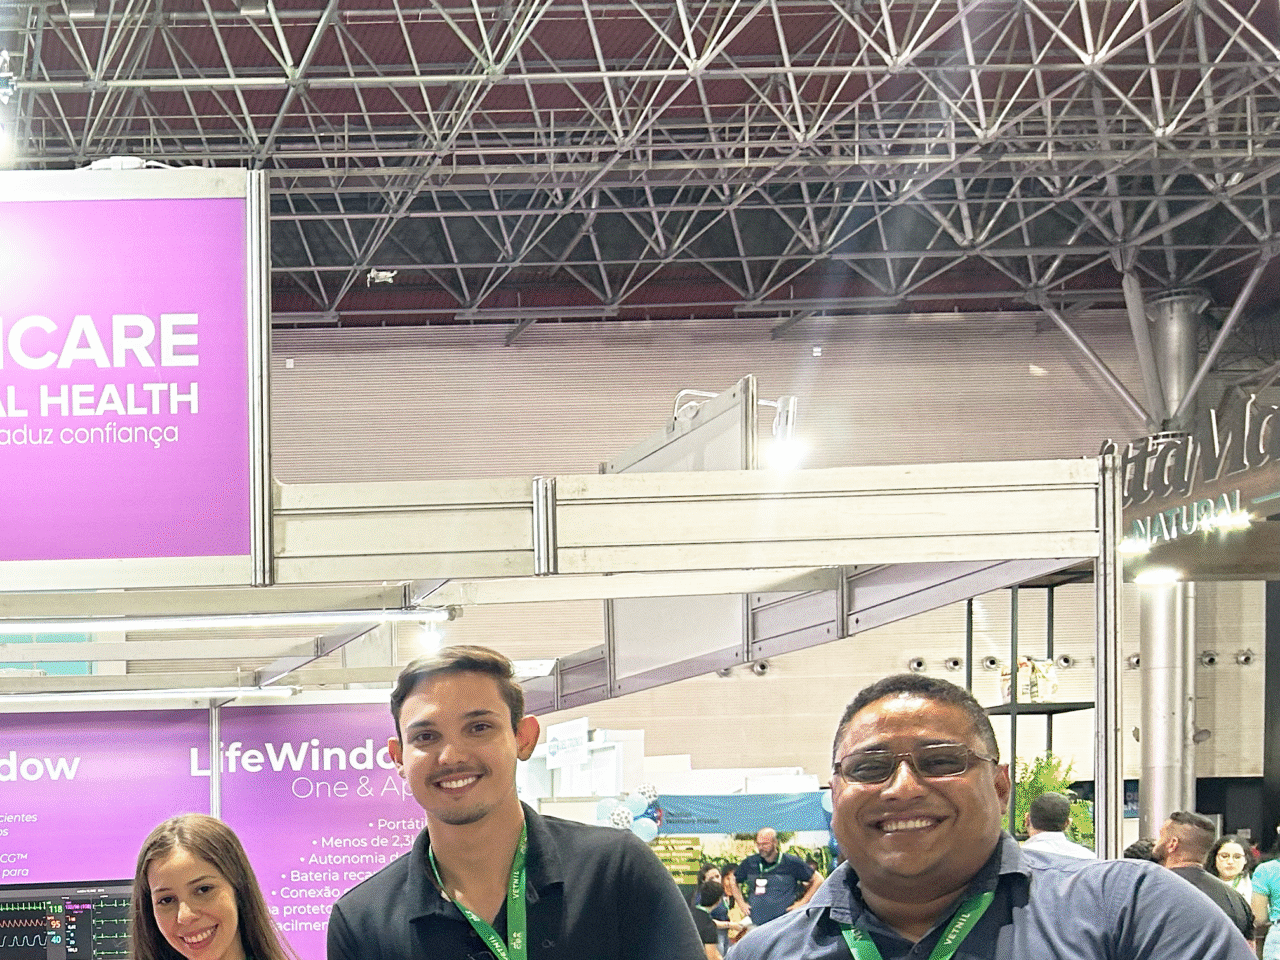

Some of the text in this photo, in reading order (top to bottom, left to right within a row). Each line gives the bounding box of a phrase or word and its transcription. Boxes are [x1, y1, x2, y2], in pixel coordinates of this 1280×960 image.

[40, 381, 200, 417] HEALTH
[60, 422, 180, 450] confiança
[291, 776, 349, 799] One
[356, 775, 374, 797] &
[321, 836, 368, 848] Menos
[371, 835, 389, 847] de
[308, 853, 387, 865] Autonomia
[2, 868, 30, 879] para
[290, 868, 340, 882] Bateria
[280, 886, 340, 899] Conexão
[512, 870, 520, 899] VETNIL
[943, 912, 971, 945] VETNIL
